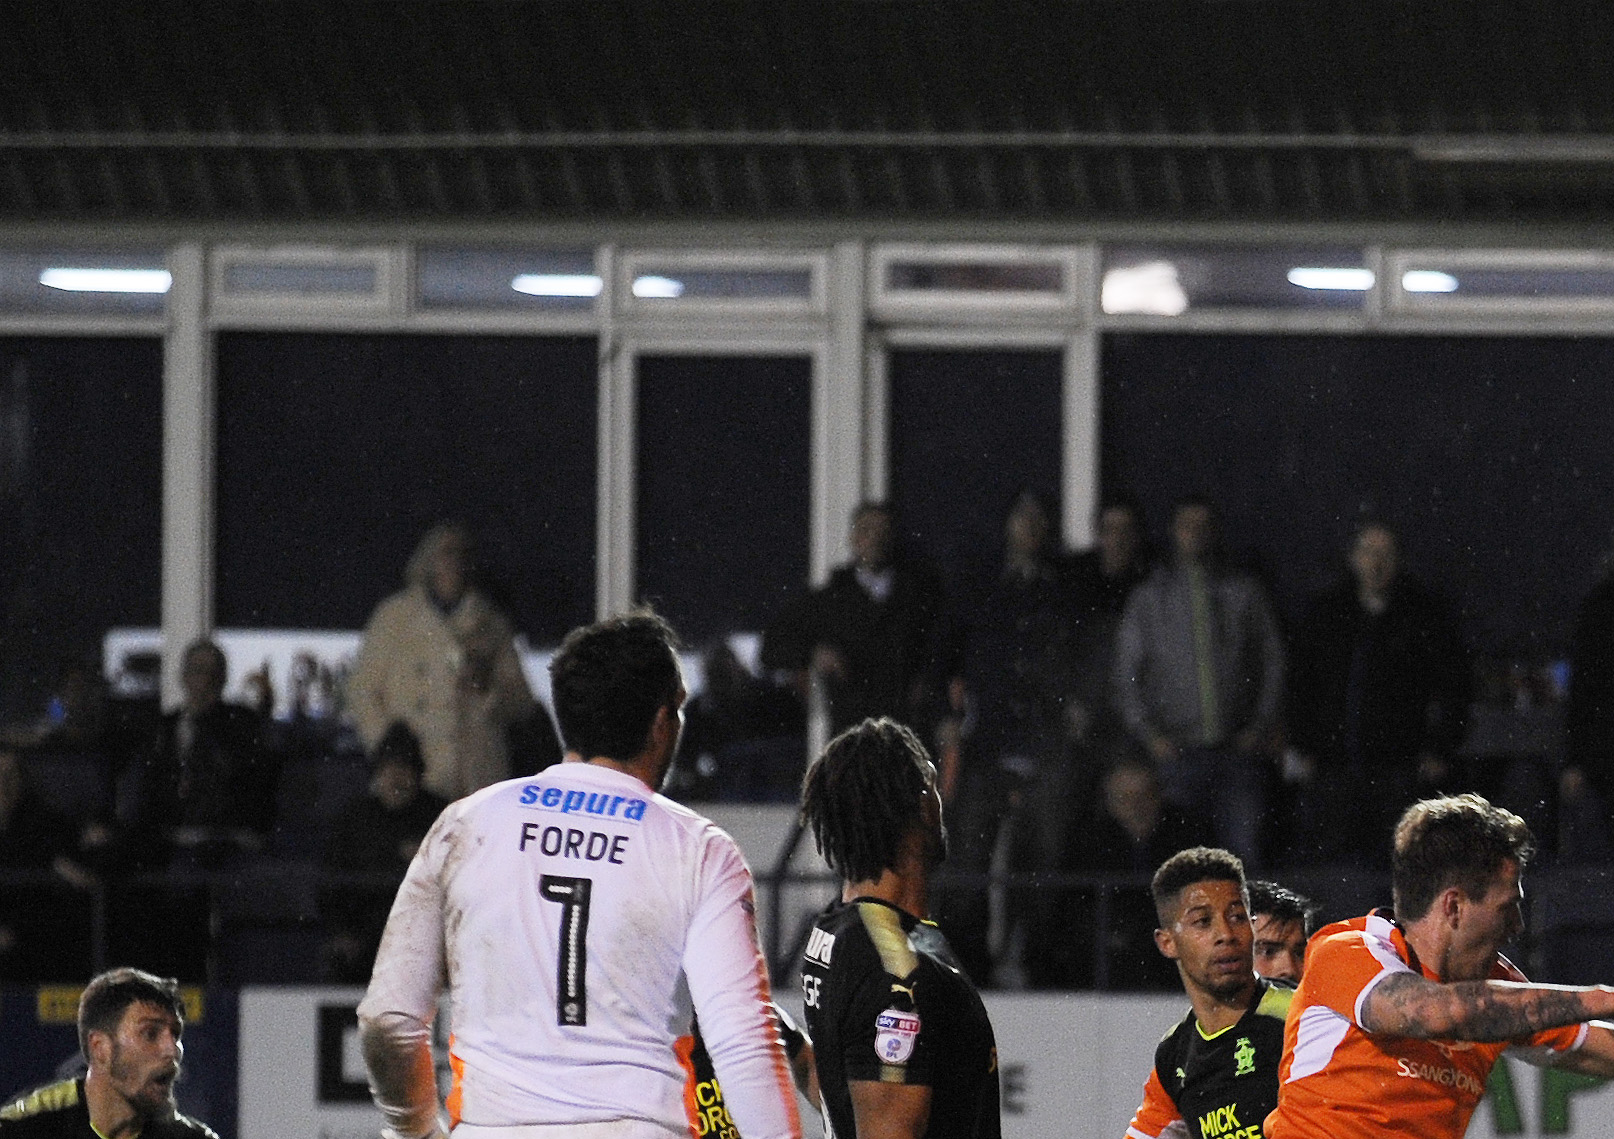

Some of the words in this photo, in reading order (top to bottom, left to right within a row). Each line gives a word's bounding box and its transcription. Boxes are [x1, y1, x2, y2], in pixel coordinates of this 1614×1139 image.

[519, 784, 647, 822] sepura
[519, 822, 629, 865] FORDE
[538, 873, 593, 1027] 1
[1396, 1057, 1484, 1097] SSANGYON
